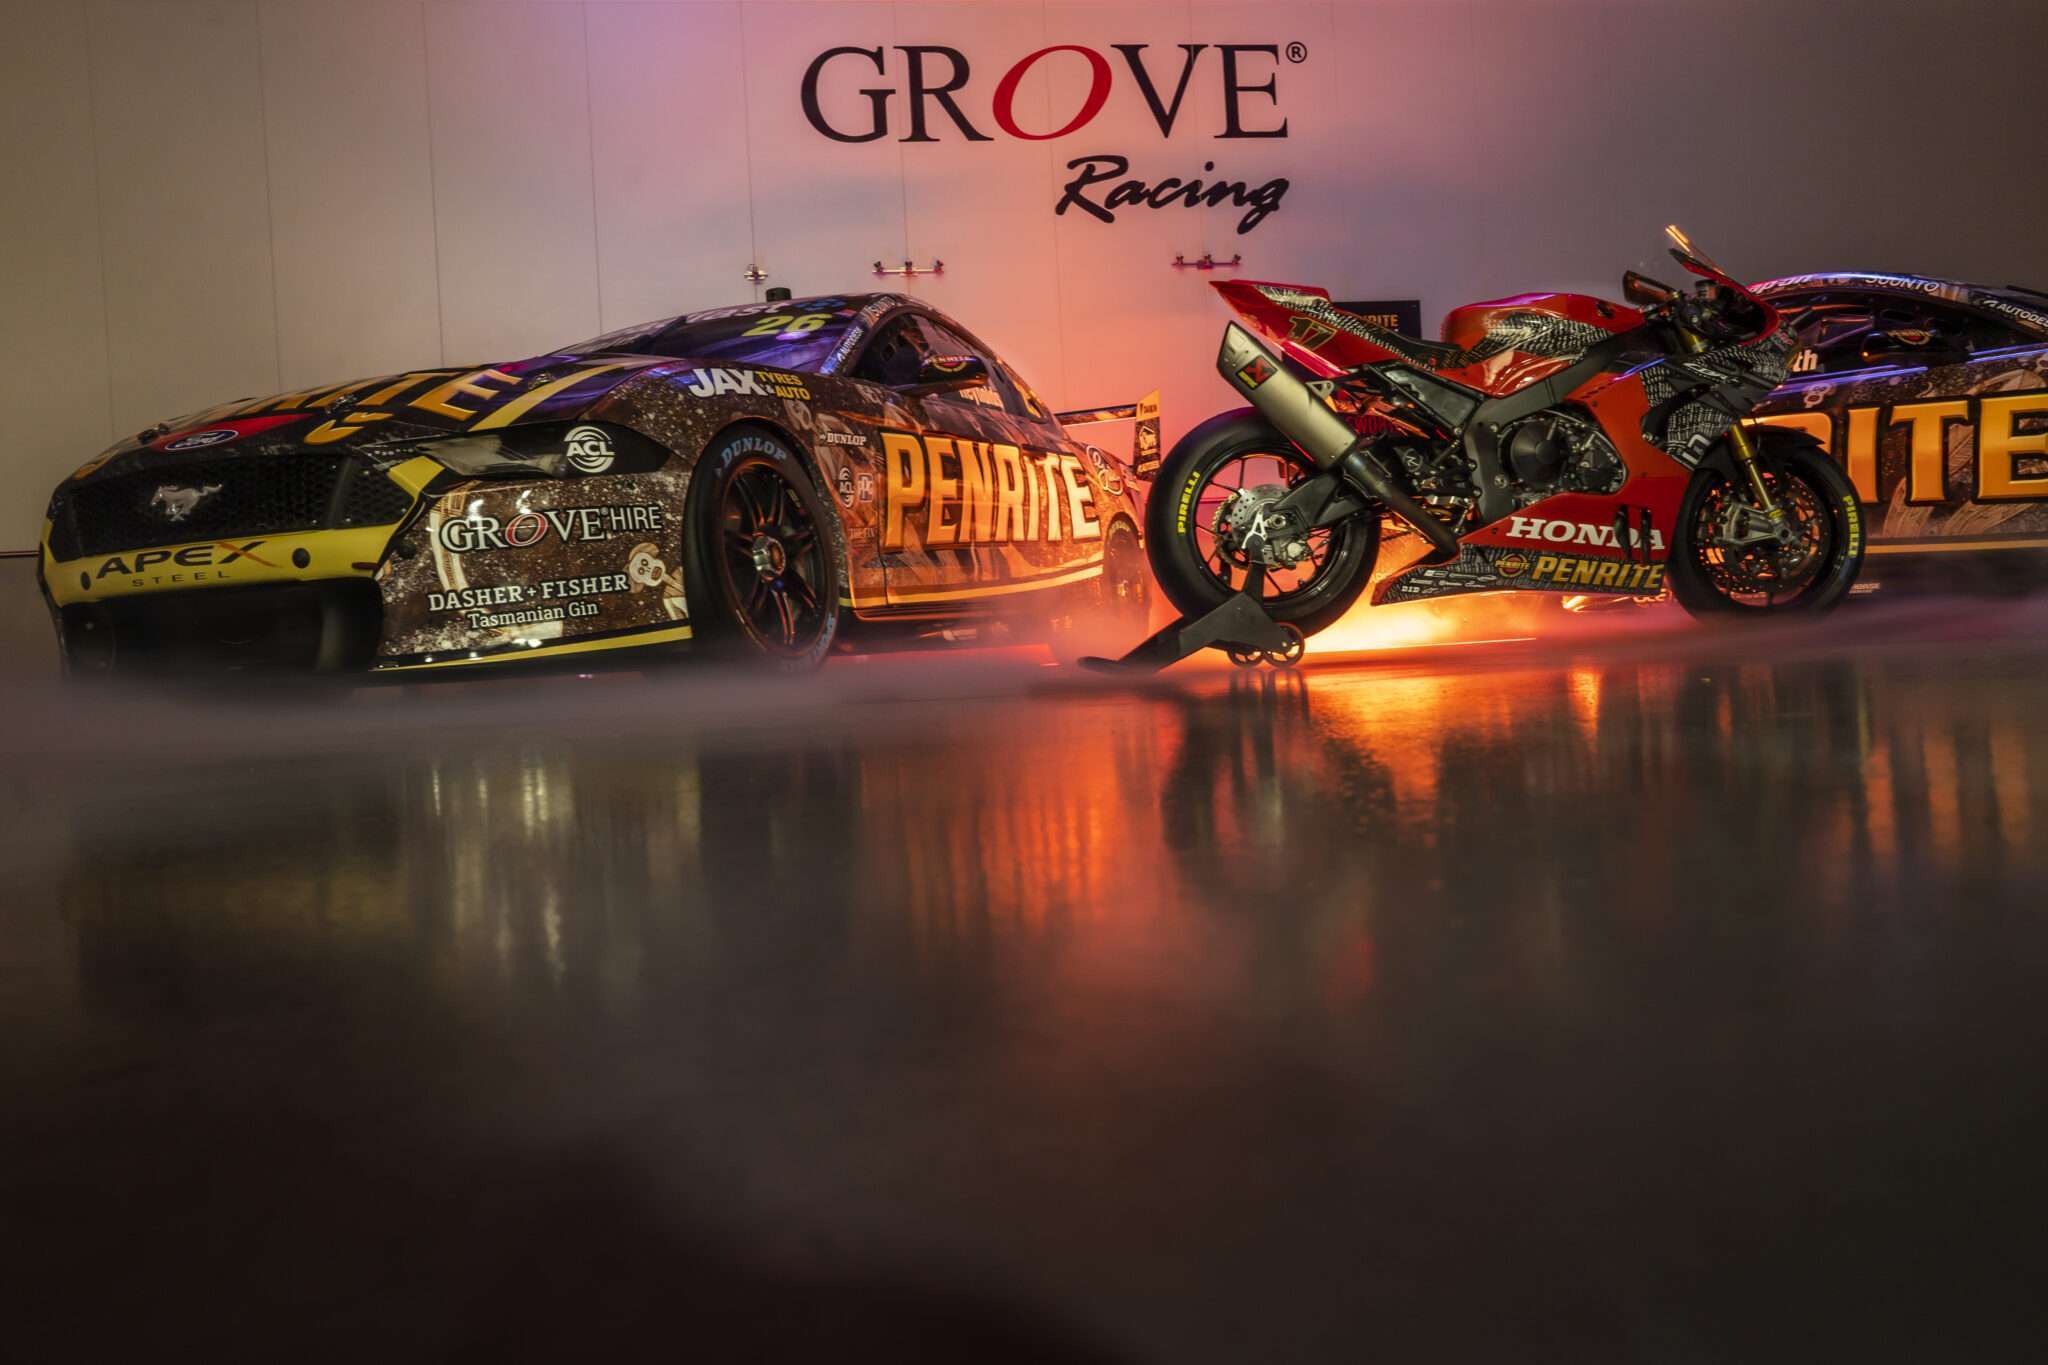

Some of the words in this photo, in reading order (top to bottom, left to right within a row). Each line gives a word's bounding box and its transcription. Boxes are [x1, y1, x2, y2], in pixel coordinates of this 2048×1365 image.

[1055, 154, 1290, 235] Racing
[741, 313, 833, 337] 26
[1288, 316, 1338, 351] 17
[1792, 349, 1819, 373] th
[688, 367, 770, 399] JAX
[754, 370, 803, 386] TYRES
[774, 384, 811, 401] AUTO
[566, 440, 616, 457] ACL
[720, 436, 788, 468] DUNLOP
[826, 432, 867, 446] DUNLOP
[880, 431, 1101, 549] PENRITE
[1177, 470, 1201, 535] PIRELLI
[610, 506, 663, 531] HIRE
[1506, 515, 1665, 550] HONDA
[1842, 495, 1860, 557] PIRELLI
[95, 540, 283, 580] APEX
[1532, 555, 1665, 589] PENRITE
[131, 570, 231, 588] STEEL
[427, 585, 524, 612] DASHER
[542, 573, 629, 600] FISHER
[467, 604, 566, 630] Tasmanian
[567, 601, 600, 620] Gin
